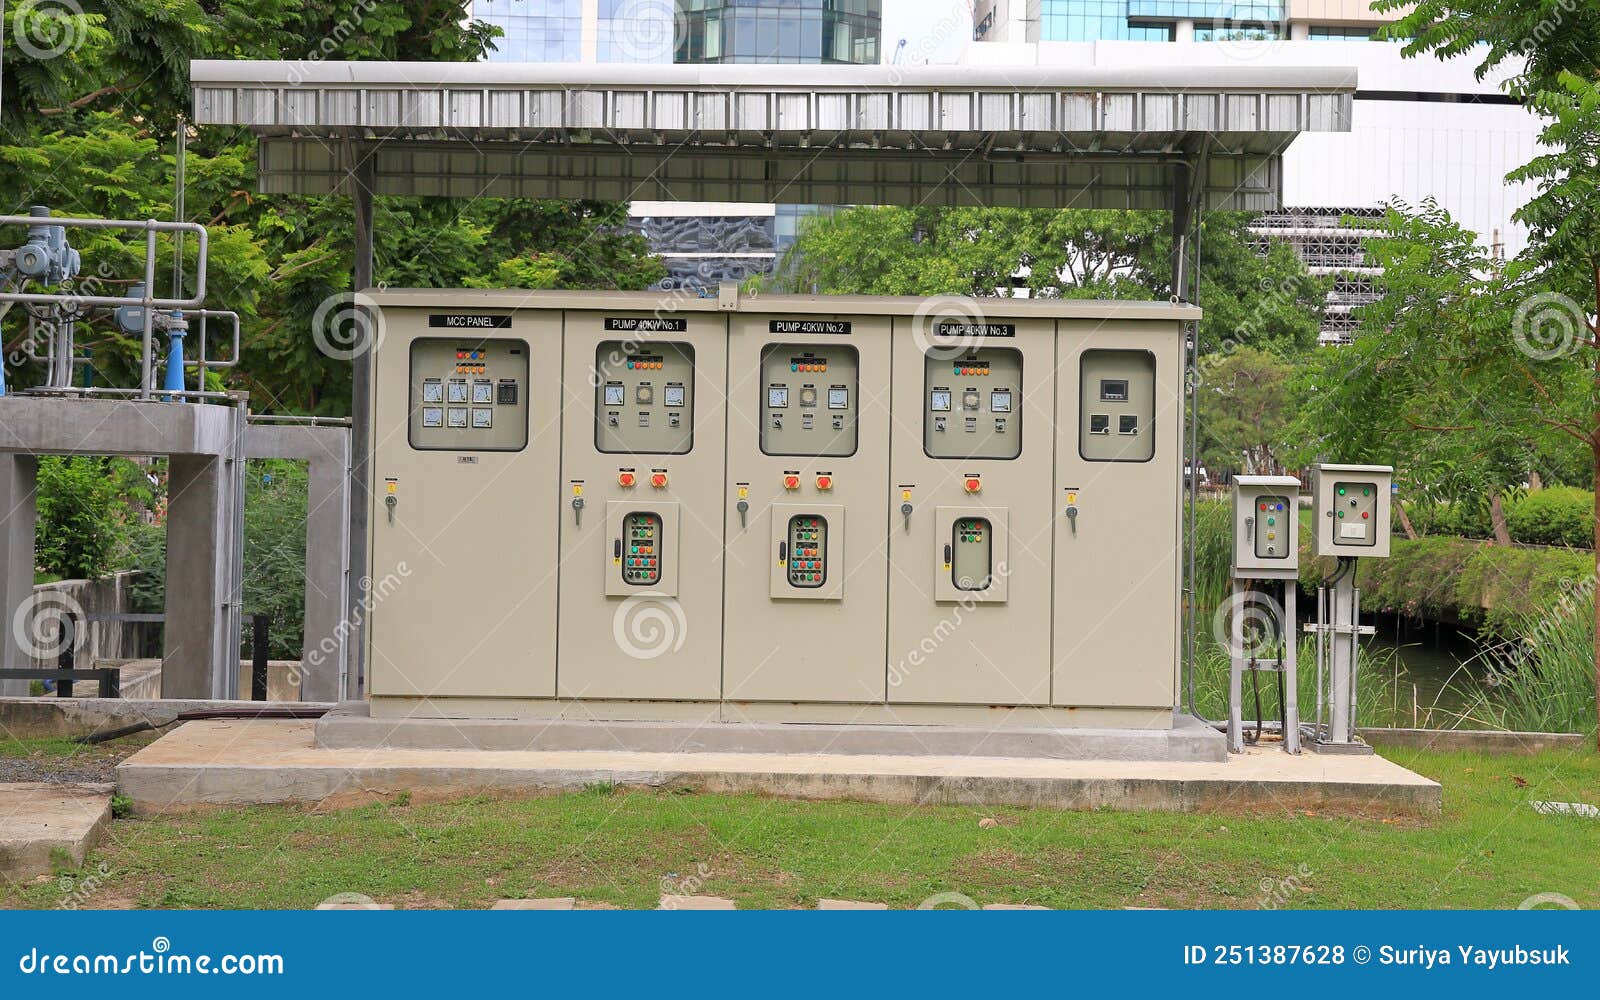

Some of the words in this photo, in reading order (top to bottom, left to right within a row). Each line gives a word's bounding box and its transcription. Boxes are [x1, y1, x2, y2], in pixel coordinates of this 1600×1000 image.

[446, 316, 466, 326] MCC
[467, 316, 494, 327] PANEL
[612, 319, 637, 329] PUMP
[638, 320, 661, 330] 40KW
[662, 320, 679, 330] No.1
[776, 321, 800, 332] PUMP
[801, 322, 825, 333] 40KW
[826, 323, 844, 333] No.2
[940, 324, 964, 335] PUMP
[965, 325, 989, 336] 40KW
[990, 326, 1008, 336] No.3
